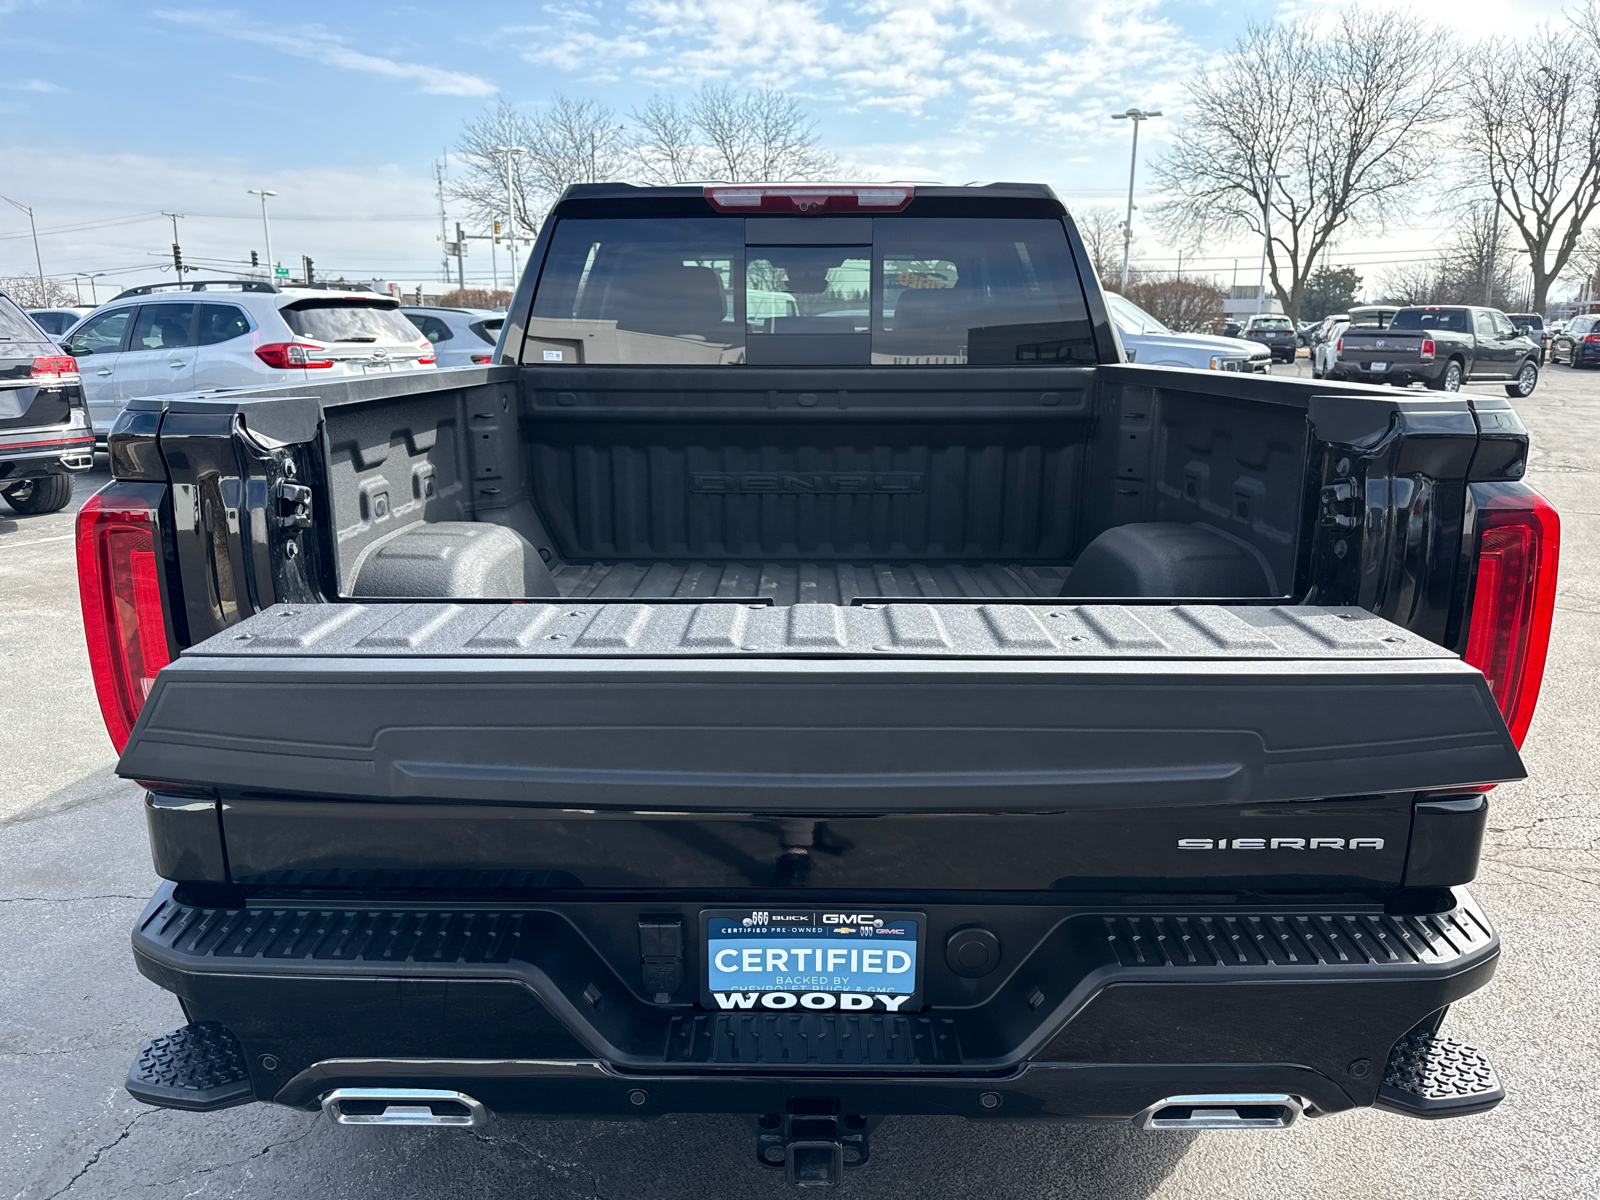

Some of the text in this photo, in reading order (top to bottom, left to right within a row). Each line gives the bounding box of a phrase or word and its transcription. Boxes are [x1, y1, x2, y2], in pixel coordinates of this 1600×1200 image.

[690, 473, 922, 493] DENALI
[1177, 837, 1385, 850] SIERRA
[822, 914, 875, 924] GMC
[714, 948, 912, 974] CERTIFIED
[776, 976, 850, 985] BACKED BY
[713, 992, 911, 1012] WOODY
